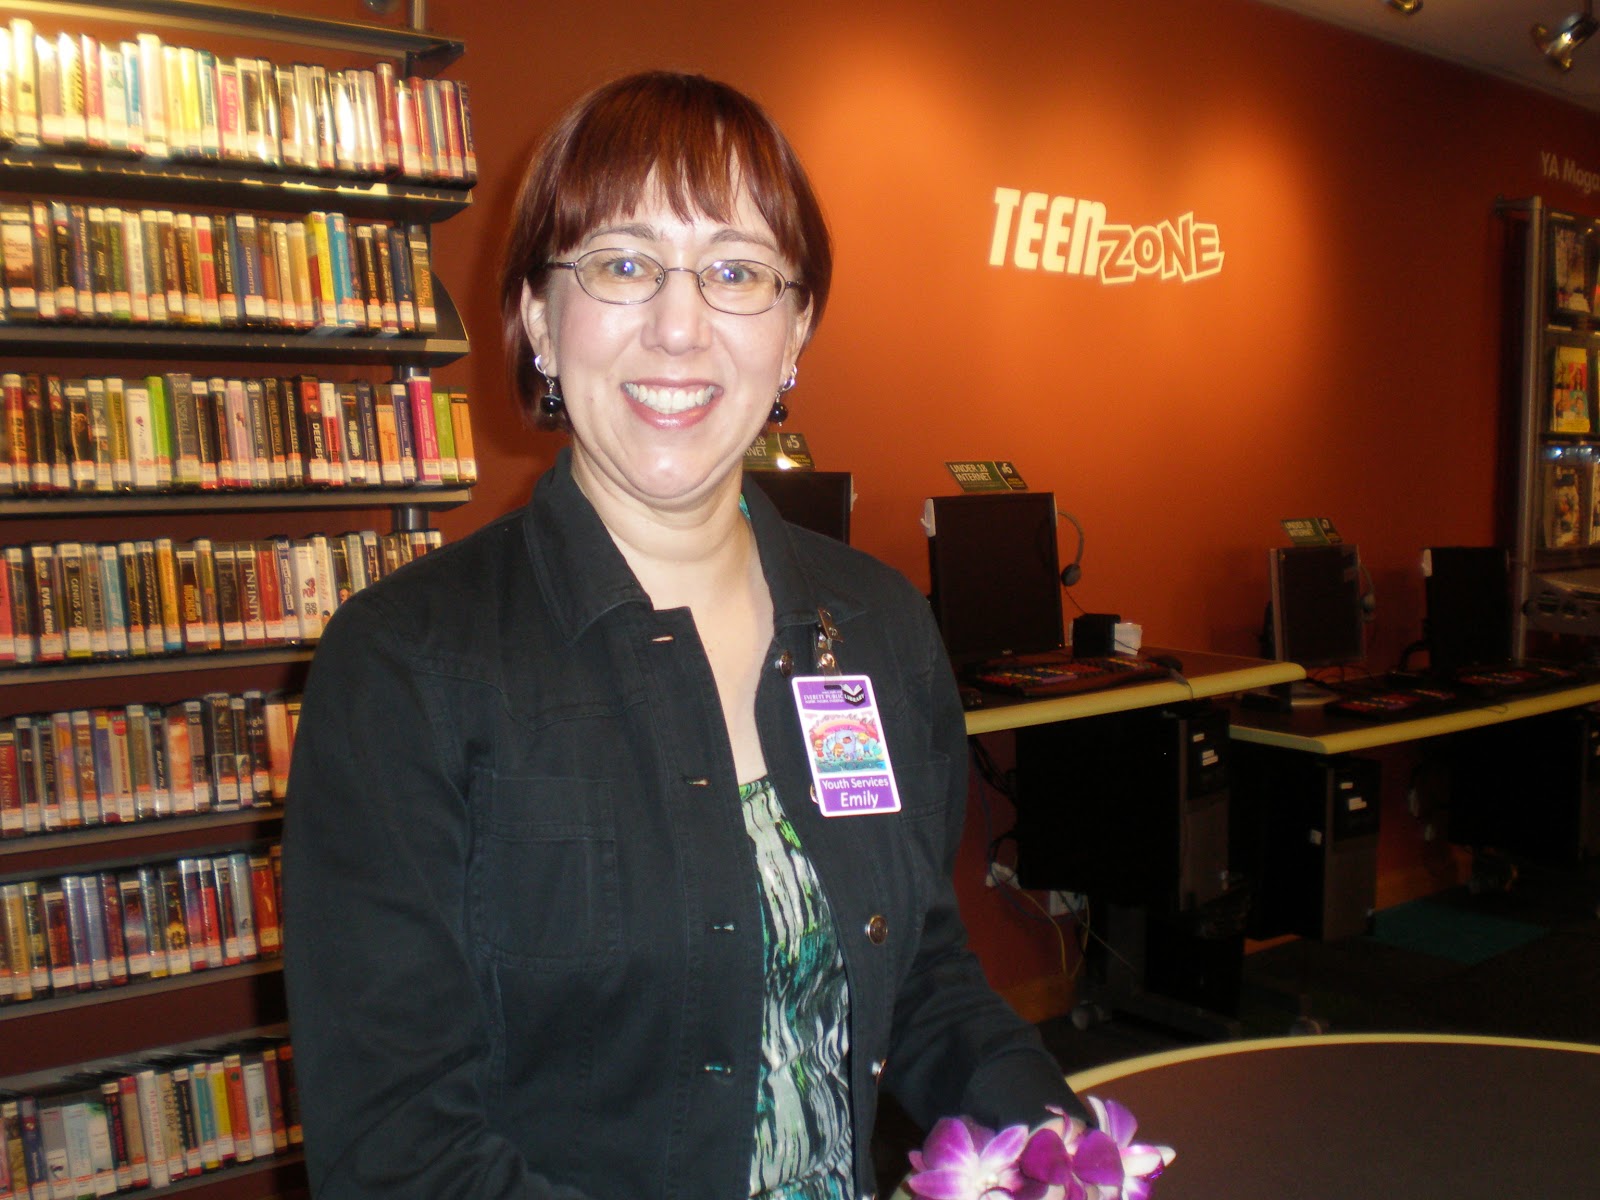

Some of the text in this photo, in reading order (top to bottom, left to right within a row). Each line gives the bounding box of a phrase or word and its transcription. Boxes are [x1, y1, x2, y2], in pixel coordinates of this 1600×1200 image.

[1541, 151, 1560, 179] YA
[1097, 211, 1225, 285] ZONE
[245, 247, 255, 294] LAMPLIGHTER
[420, 269, 431, 298] Along
[270, 400, 281, 452] RULES WORLD
[312, 423, 323, 459] DEEPER
[744, 446, 767, 457] NET
[786, 434, 801, 449] #5
[949, 464, 989, 473] UNDER 18
[955, 472, 992, 482] INTERNET
[41, 587, 50, 606] EVIL
[71, 578, 81, 608] GENIUS
[183, 585, 197, 621] MUCHACHO
[245, 569, 258, 622] INFINITY
[844, 693, 865, 703] LIBRARY
[822, 777, 889, 790] Youth Services
[840, 789, 879, 808] Emily
